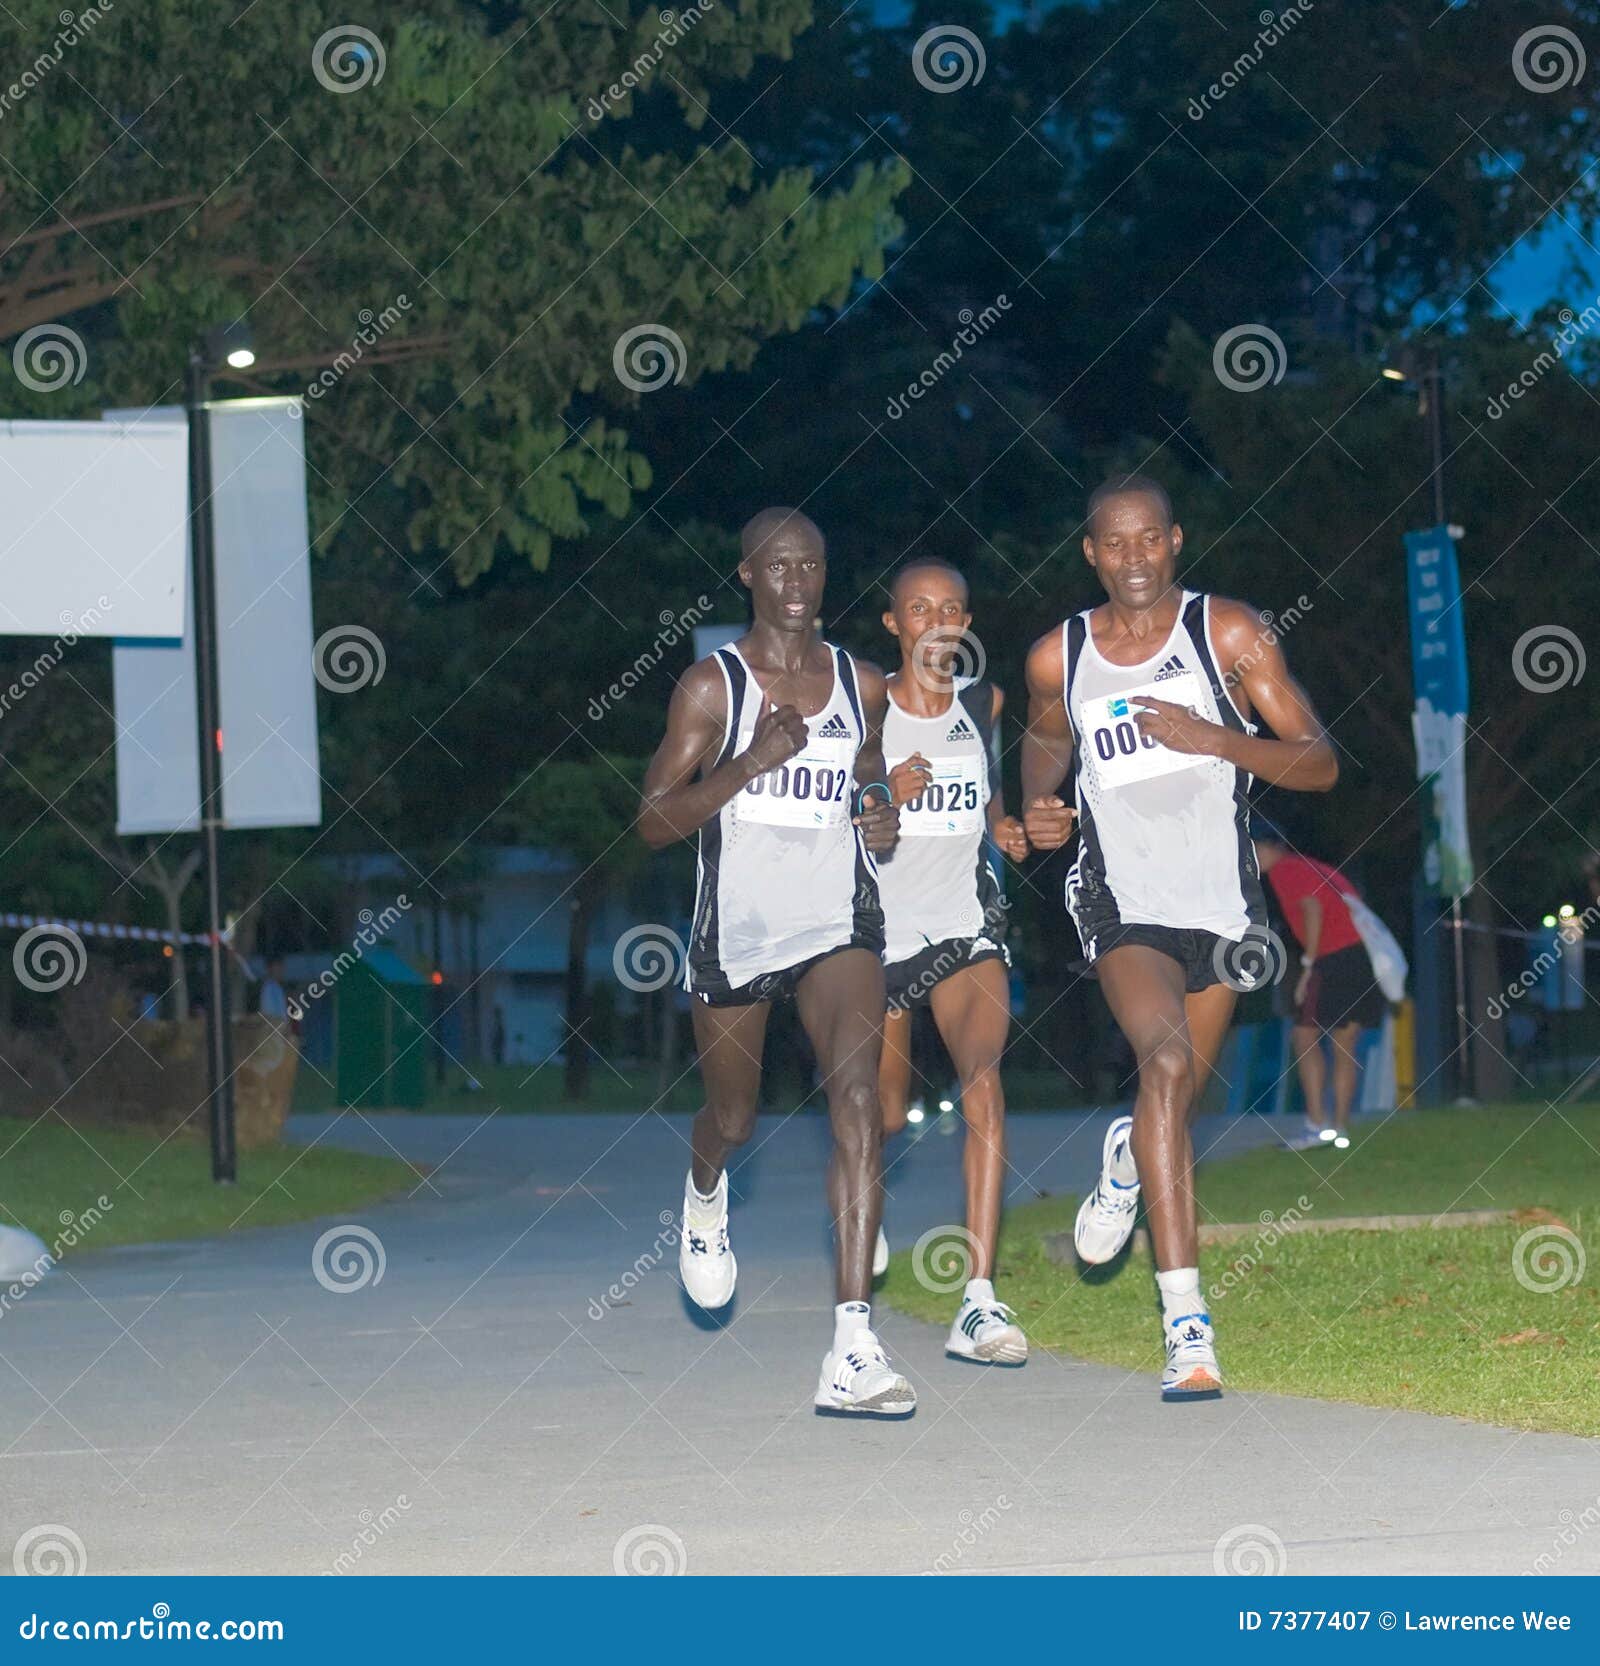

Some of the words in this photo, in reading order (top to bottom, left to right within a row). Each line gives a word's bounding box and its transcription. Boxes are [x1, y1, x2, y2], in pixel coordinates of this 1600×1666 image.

[1154, 669, 1192, 682] adida
[818, 728, 852, 739] adidas
[946, 732, 975, 742] adidas
